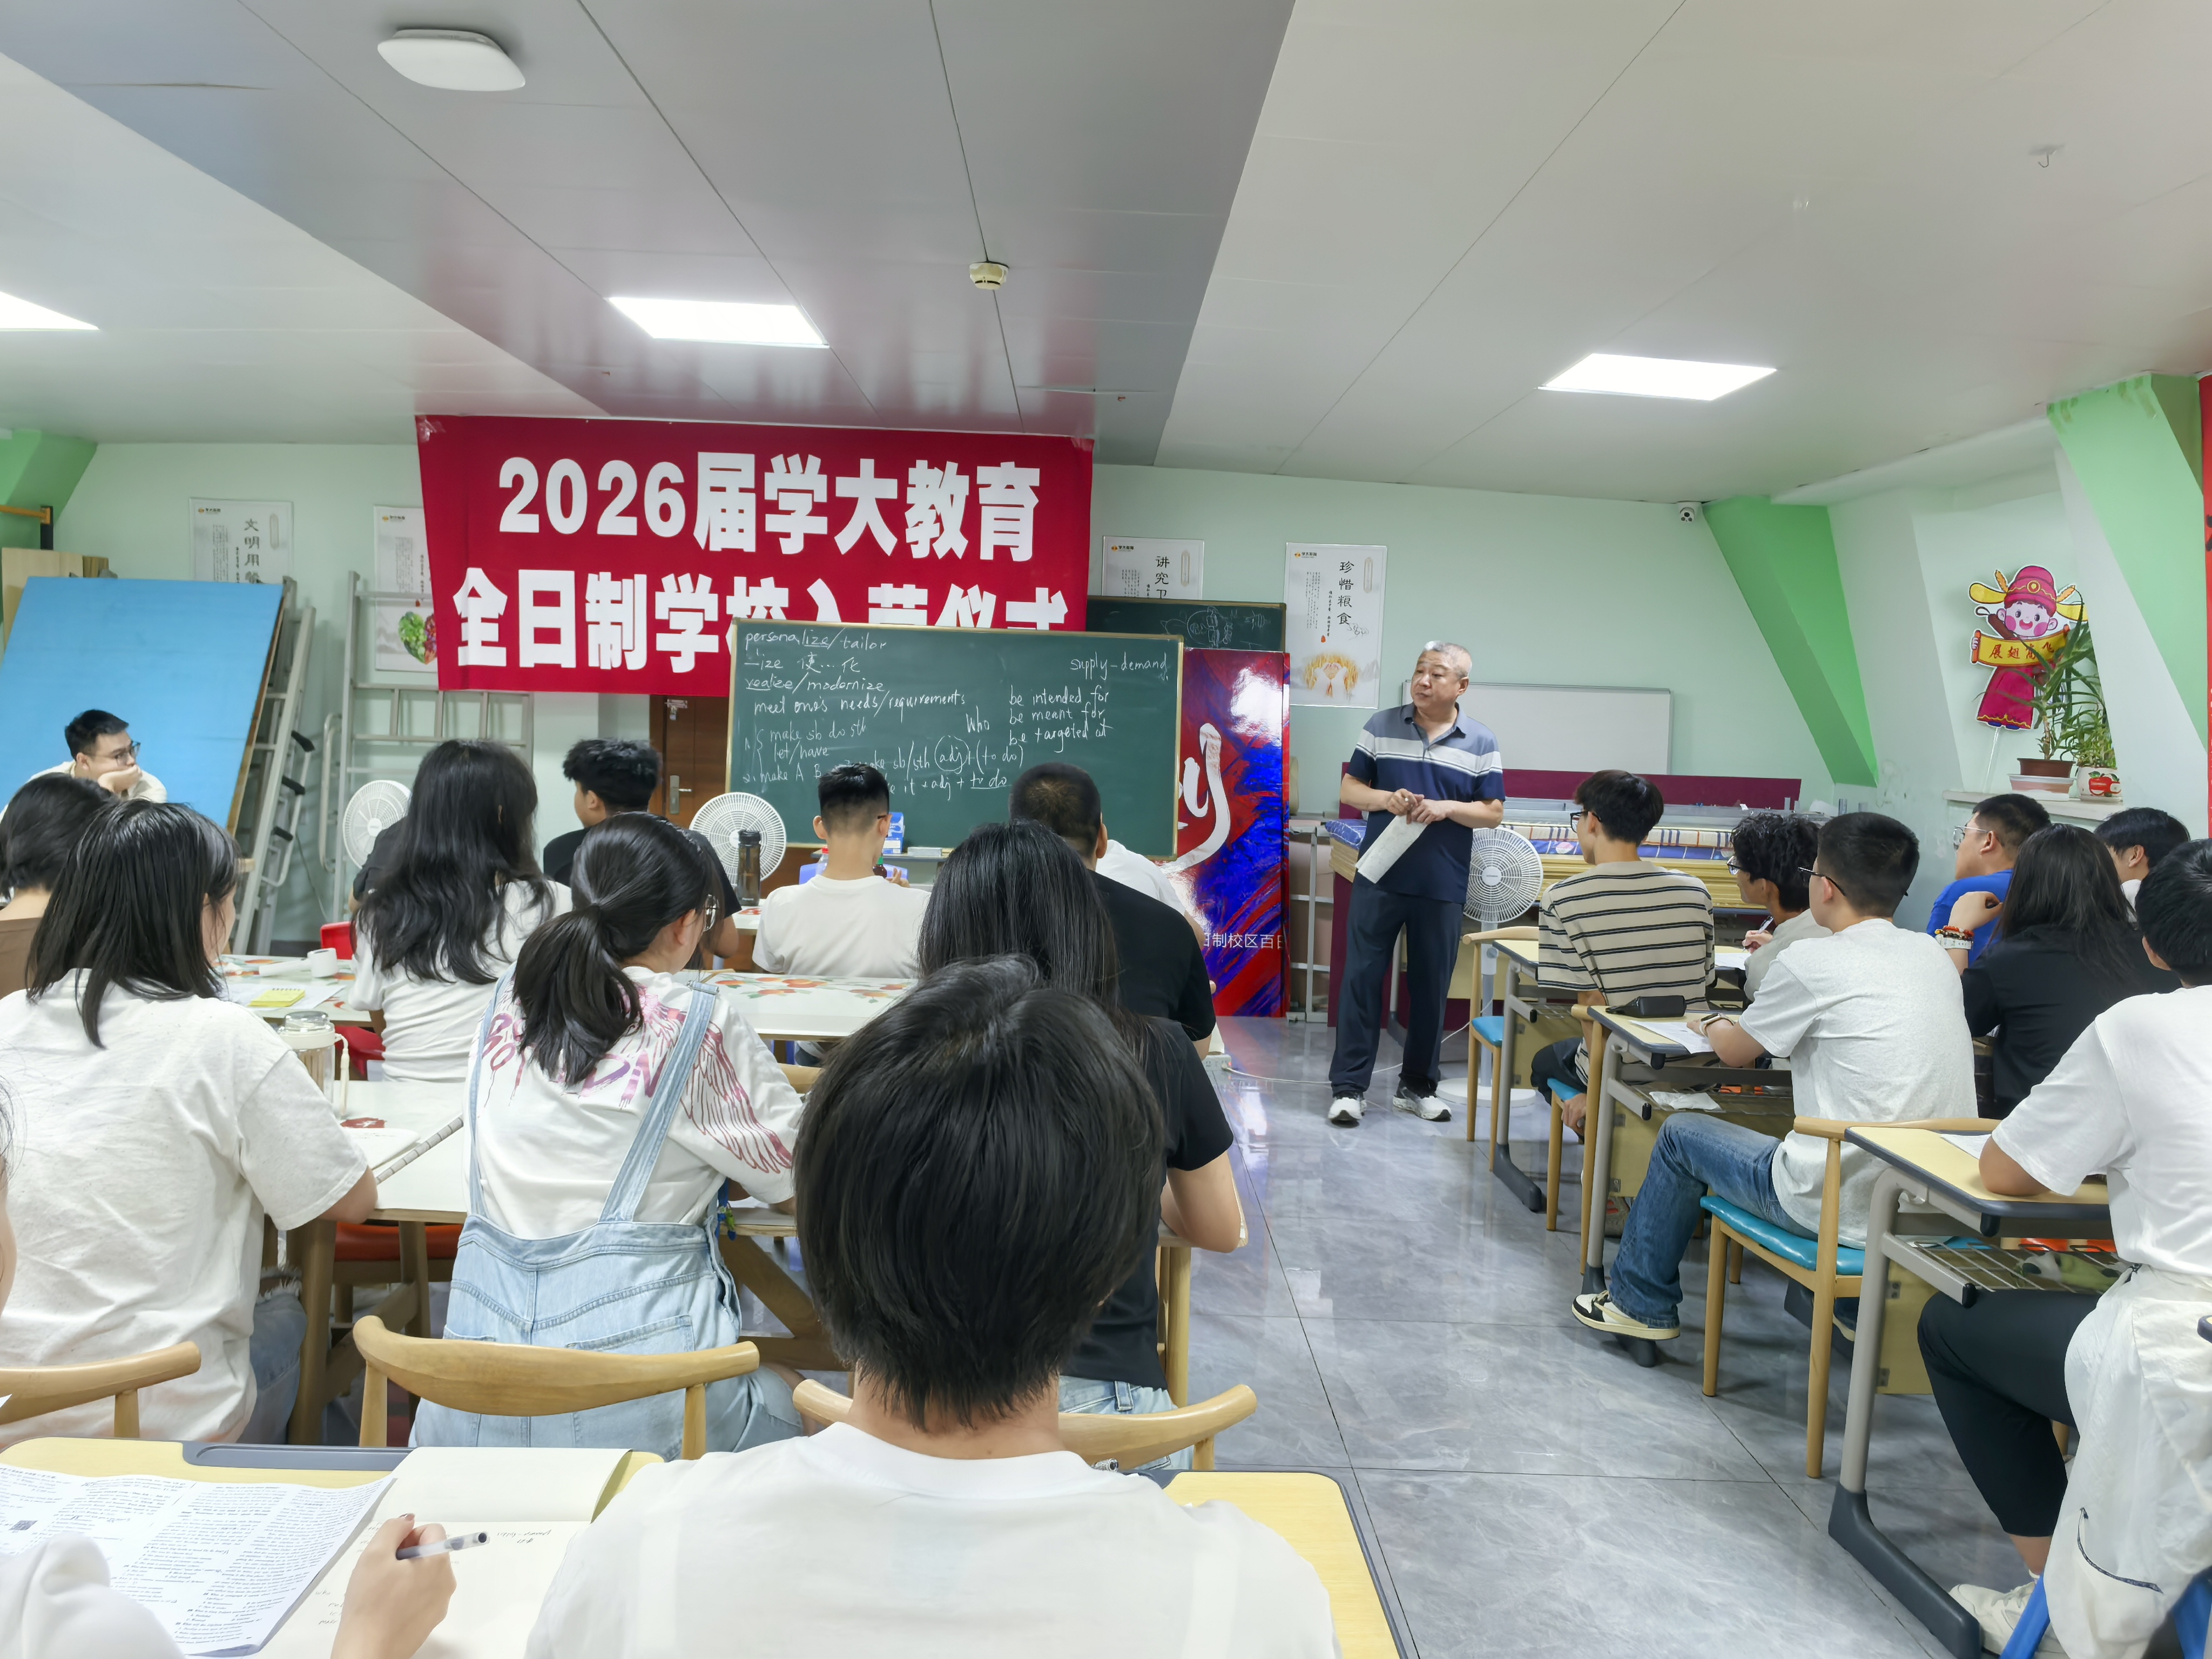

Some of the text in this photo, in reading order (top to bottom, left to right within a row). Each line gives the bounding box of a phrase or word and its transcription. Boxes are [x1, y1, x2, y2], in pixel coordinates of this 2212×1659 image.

[498, 451, 1040, 562] 2026届学大教育
[1337, 561, 1354, 625] 珍惜粮食
[754, 695, 785, 716] meet
[1009, 685, 1109, 712] be intended for
[1009, 702, 1105, 725] be meant for
[770, 720, 802, 742] make
[806, 719, 822, 740] sb
[828, 720, 846, 739] do
[850, 717, 867, 737] sth
[1009, 718, 1114, 753] be targeted at
[760, 764, 788, 783] make
[795, 762, 804, 782] A
[904, 778, 915, 795] it
[931, 773, 951, 801] adj
